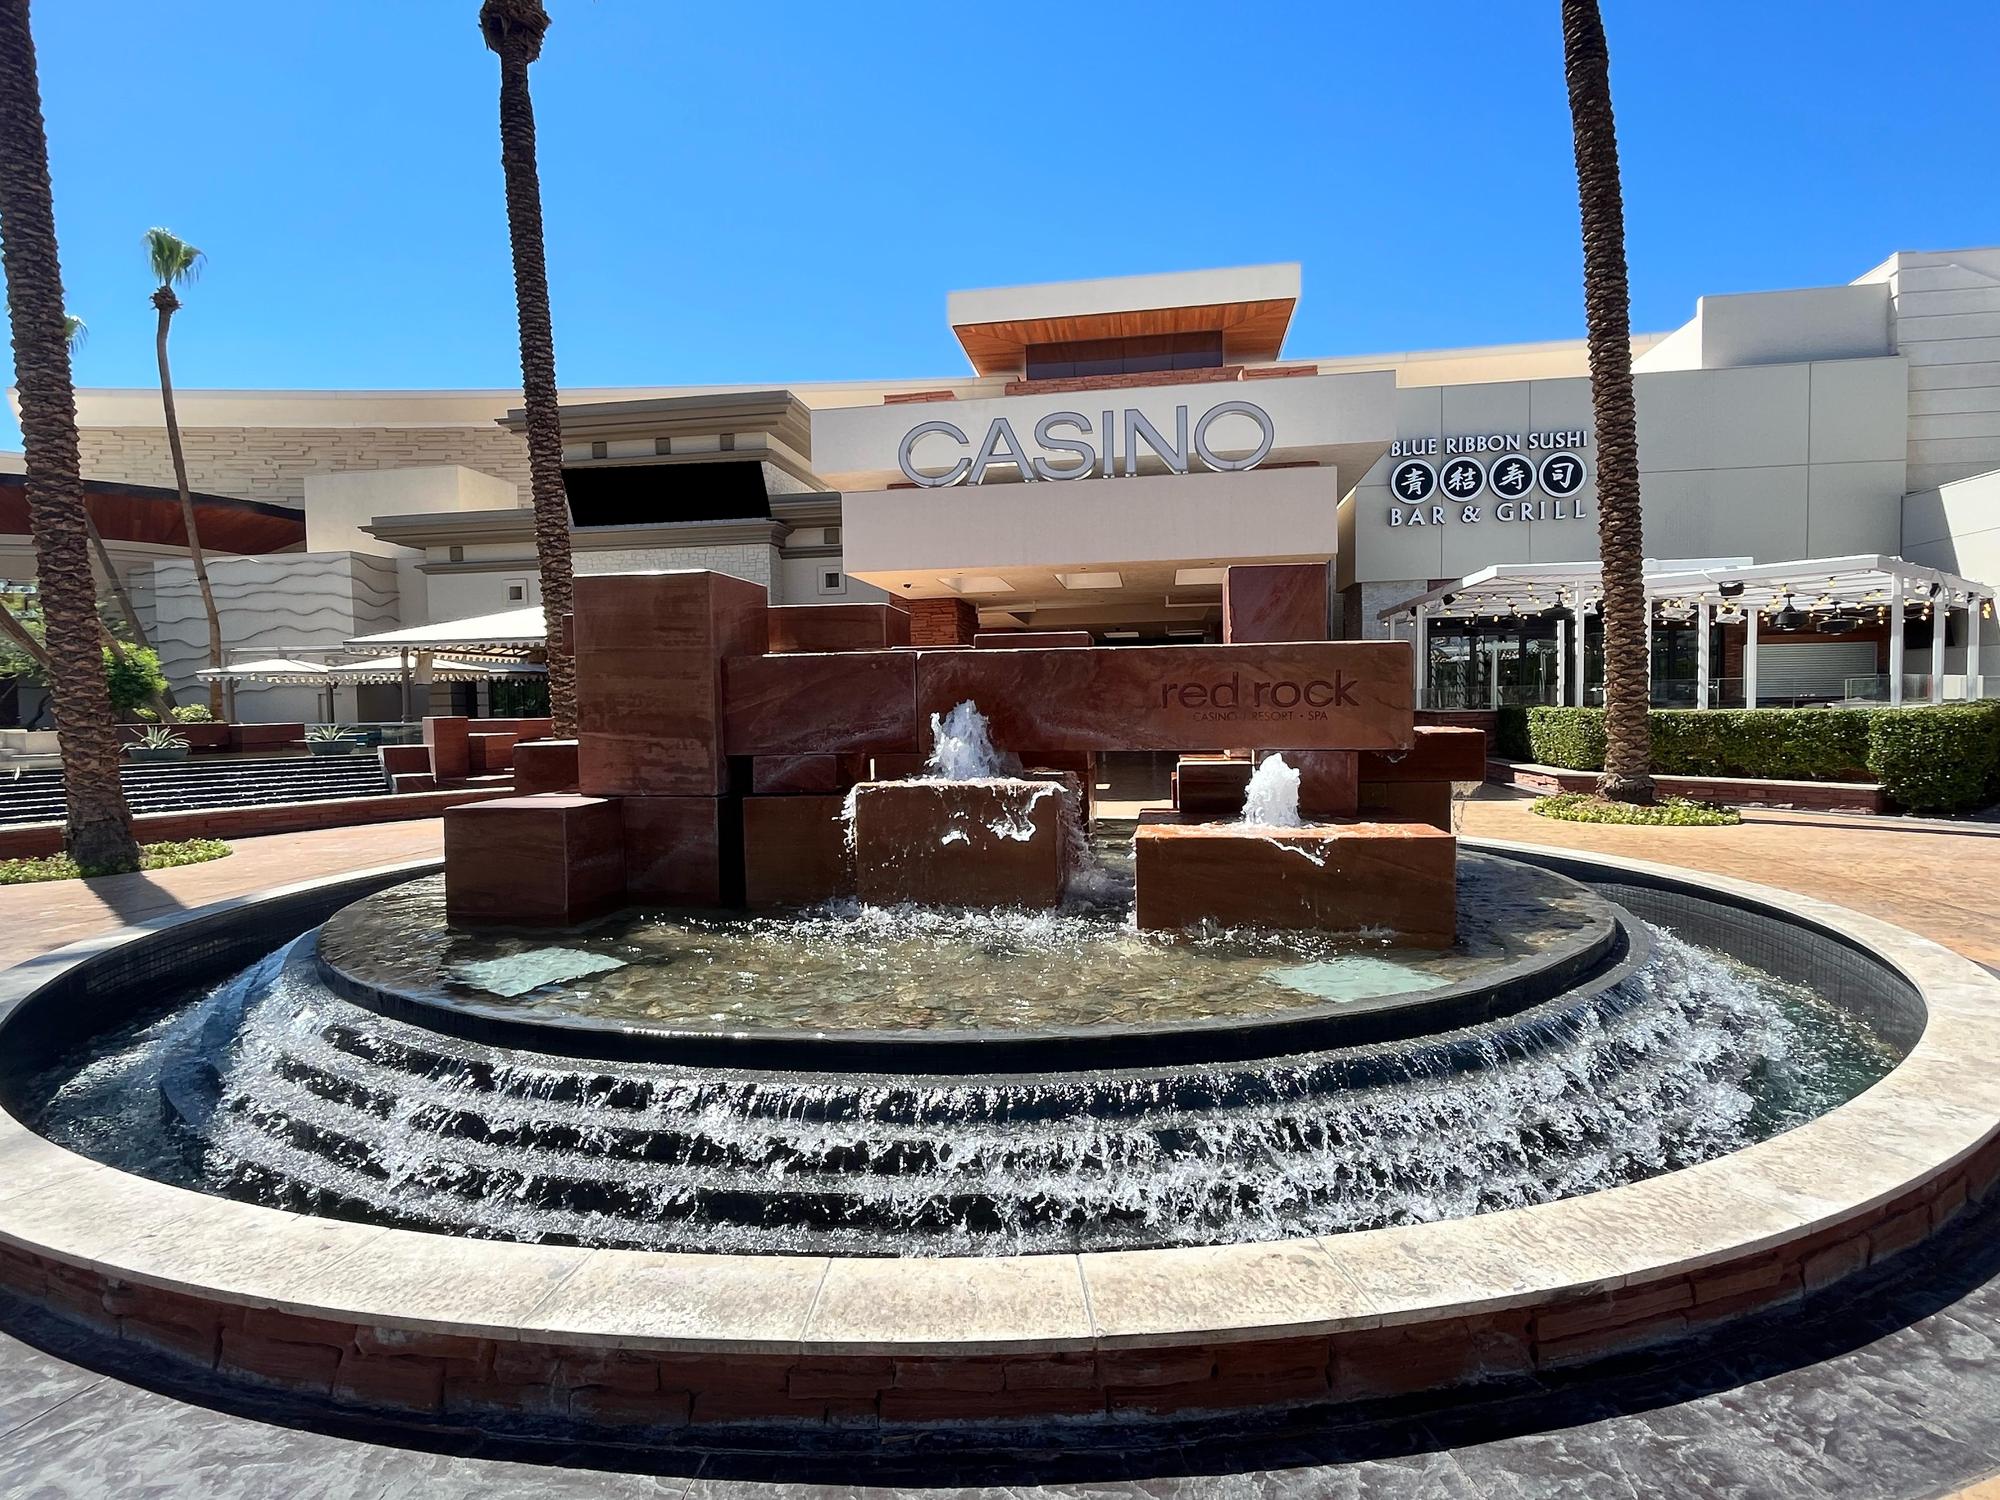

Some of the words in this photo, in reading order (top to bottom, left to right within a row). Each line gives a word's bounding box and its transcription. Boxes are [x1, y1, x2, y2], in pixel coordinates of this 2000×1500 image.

[898, 400, 1275, 488] CASINO
[1391, 438, 1438, 457] BLUE
[1446, 434, 1521, 454] RIBBON
[1528, 430, 1588, 450] SUSHI
[1390, 505, 1446, 527] BAR
[1461, 505, 1481, 523] &
[1496, 499, 1587, 522] GRILL
[1161, 671, 1239, 709] red
[1253, 669, 1360, 708] rock
[1192, 711, 1238, 722] CASINO
[1252, 711, 1294, 721] RESORT
[1308, 710, 1329, 721] SPA
